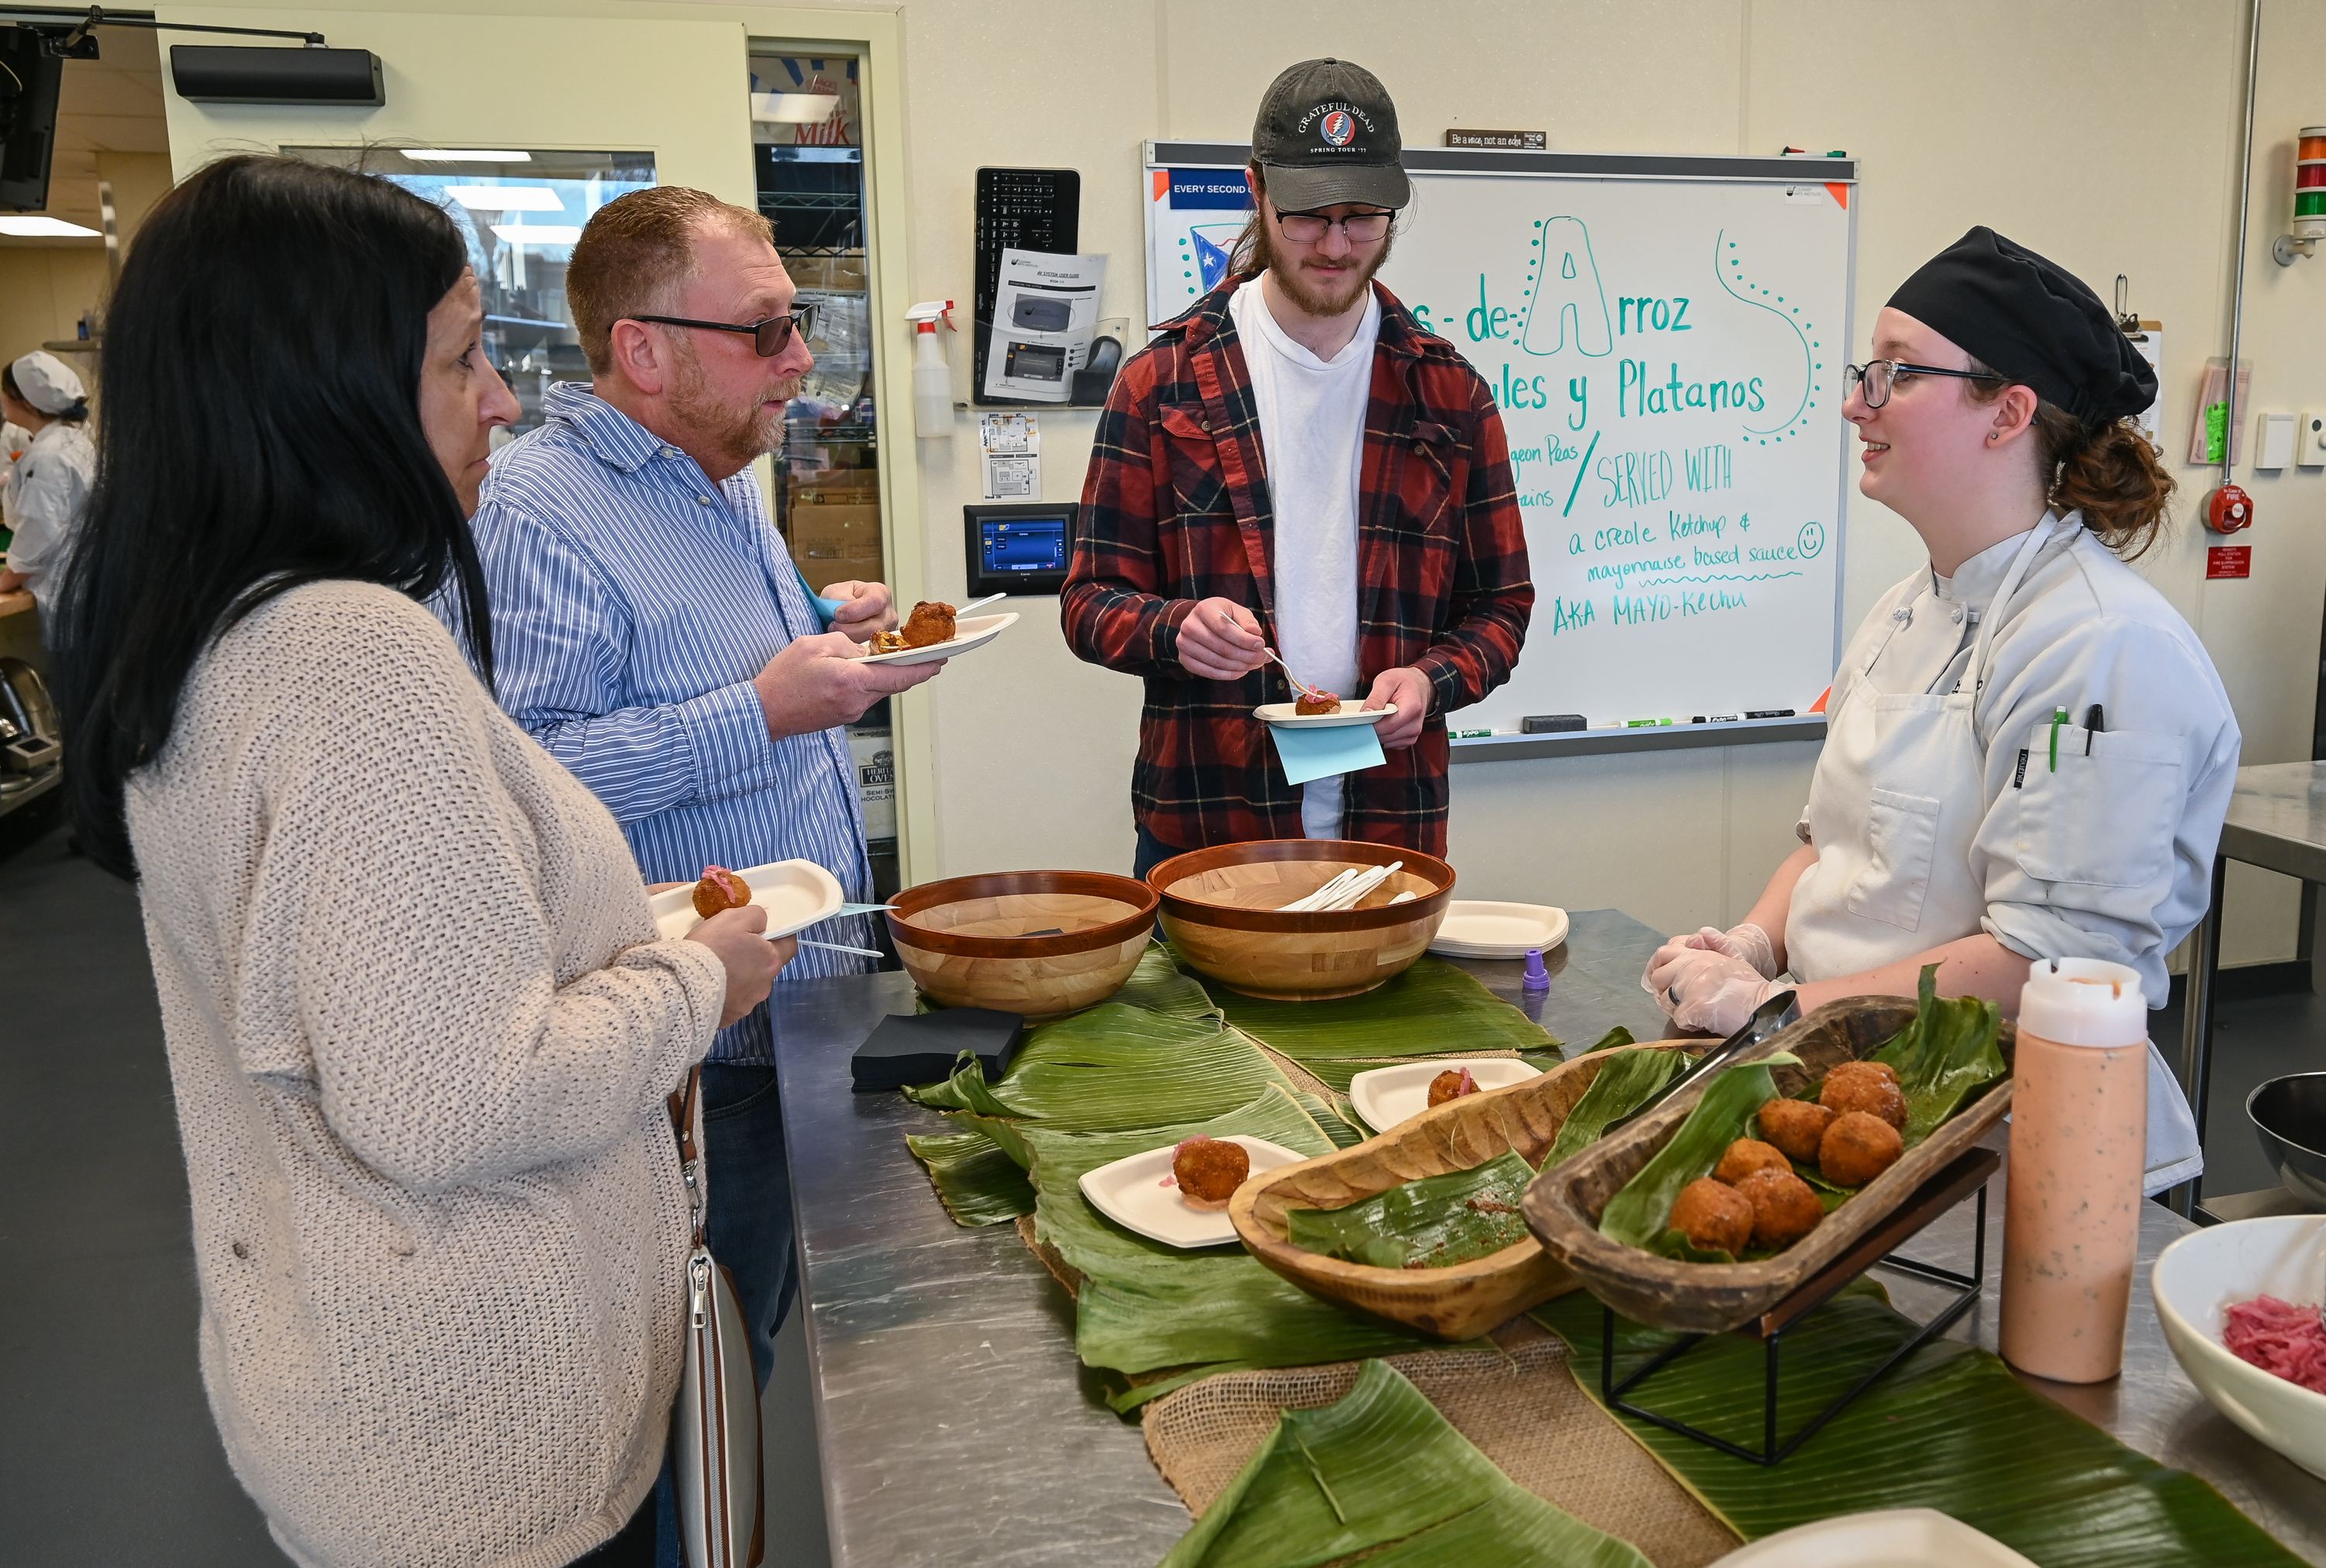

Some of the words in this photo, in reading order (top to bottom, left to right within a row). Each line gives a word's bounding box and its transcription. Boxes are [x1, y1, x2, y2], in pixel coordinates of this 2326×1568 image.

[1298, 102, 1351, 133] GRATEFUL
[1351, 105, 1375, 133] DEAD
[1451, 134, 1462, 143] Be
[1484, 136, 1496, 145] not
[1174, 184, 1205, 193] EVERY
[1206, 184, 1246, 194] SECOND
[1568, 375, 1587, 431] y
[1619, 359, 1765, 418] Platanos
[1510, 447, 1541, 484] geon
[1544, 434, 1579, 466] Peas
[1597, 450, 1672, 508] SERVED
[1685, 444, 1731, 492] WITH
[1569, 533, 1585, 555] a
[1595, 522, 1657, 551] creole
[1669, 511, 1727, 541] Ketchup
[1587, 554, 1686, 590] mayonnaise
[1693, 545, 1739, 566] based
[1748, 546, 1799, 563] sauce
[1553, 596, 1596, 636] AKA
